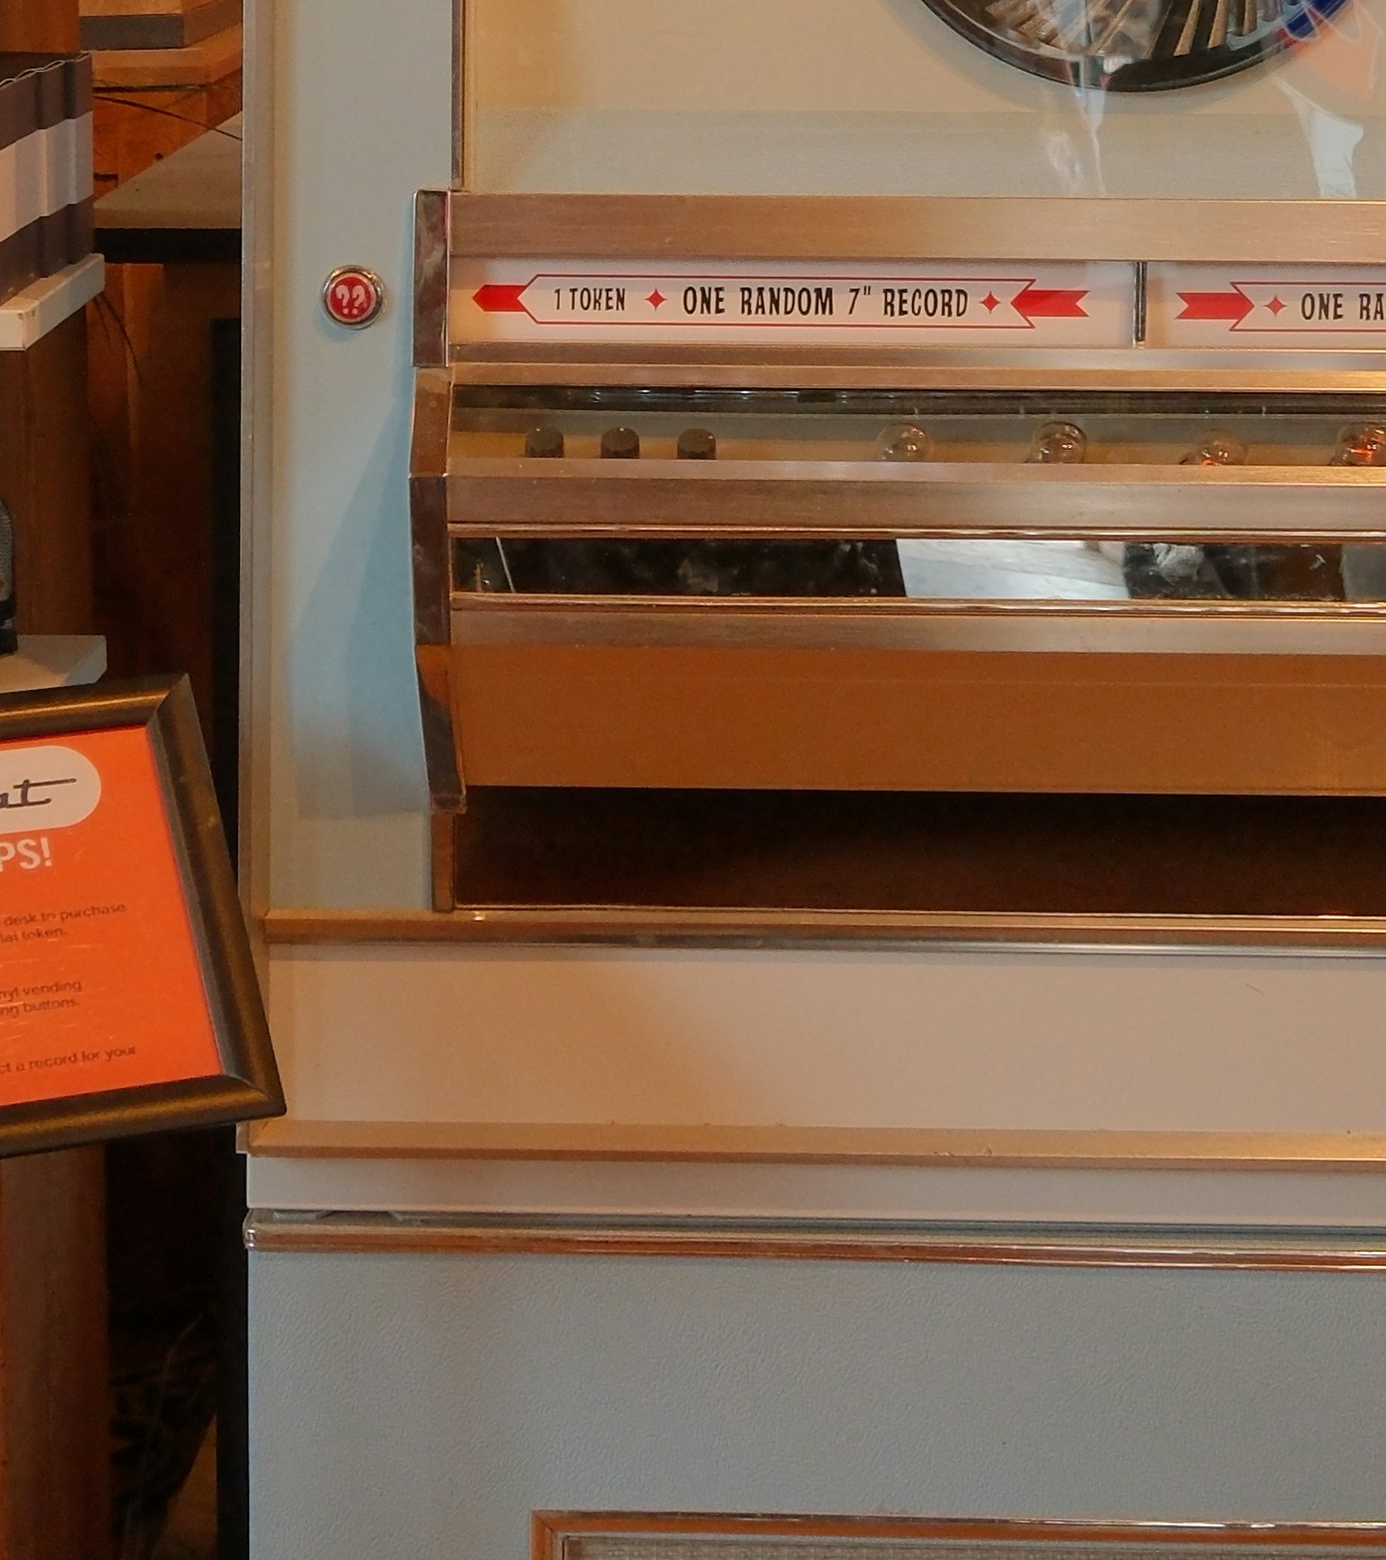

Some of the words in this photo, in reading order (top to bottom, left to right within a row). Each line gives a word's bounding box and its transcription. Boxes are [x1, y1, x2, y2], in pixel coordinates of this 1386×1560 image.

[554, 289, 562, 311] 1
[568, 288, 627, 312] TOKEN
[683, 285, 726, 317] ONE
[740, 285, 835, 317] RANDOM
[847, 285, 872, 317] 7"
[882, 287, 969, 318] RECORD
[1300, 292, 1346, 321] ONE
[4, 911, 37, 927] desk
[60, 903, 126, 923] purchase
[22, 979, 82, 998] vending
[29, 1053, 77, 1070] record
[82, 1049, 100, 1062] for
[105, 1046, 136, 1062] your
